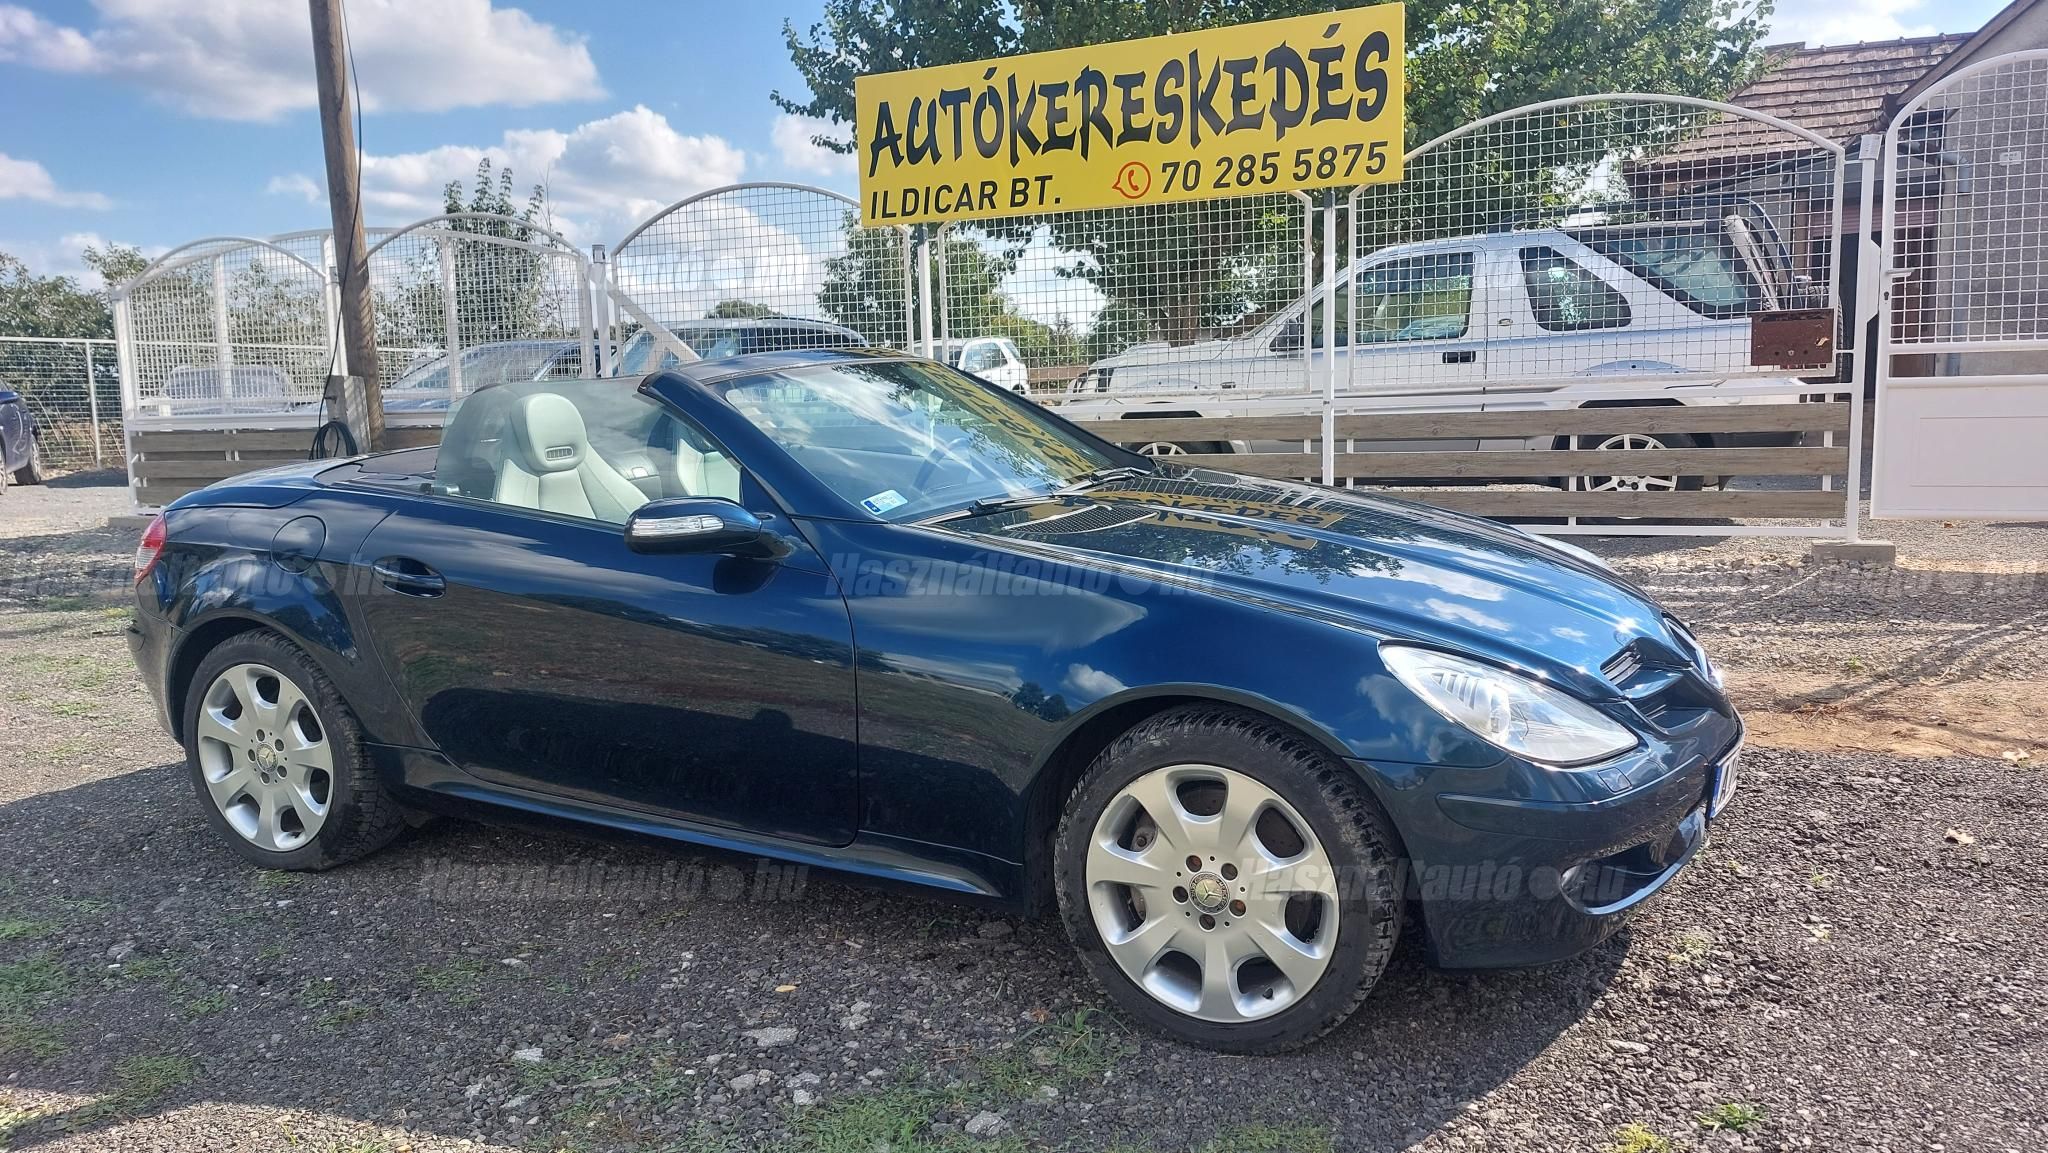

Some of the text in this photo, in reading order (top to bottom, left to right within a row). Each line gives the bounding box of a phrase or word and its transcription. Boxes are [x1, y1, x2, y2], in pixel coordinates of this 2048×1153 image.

[868, 23, 1390, 178] AUTÓKERESKEDÉS
[1161, 141, 1389, 194] 70 285 5875
[870, 175, 1062, 220] ILDICAR BT.
